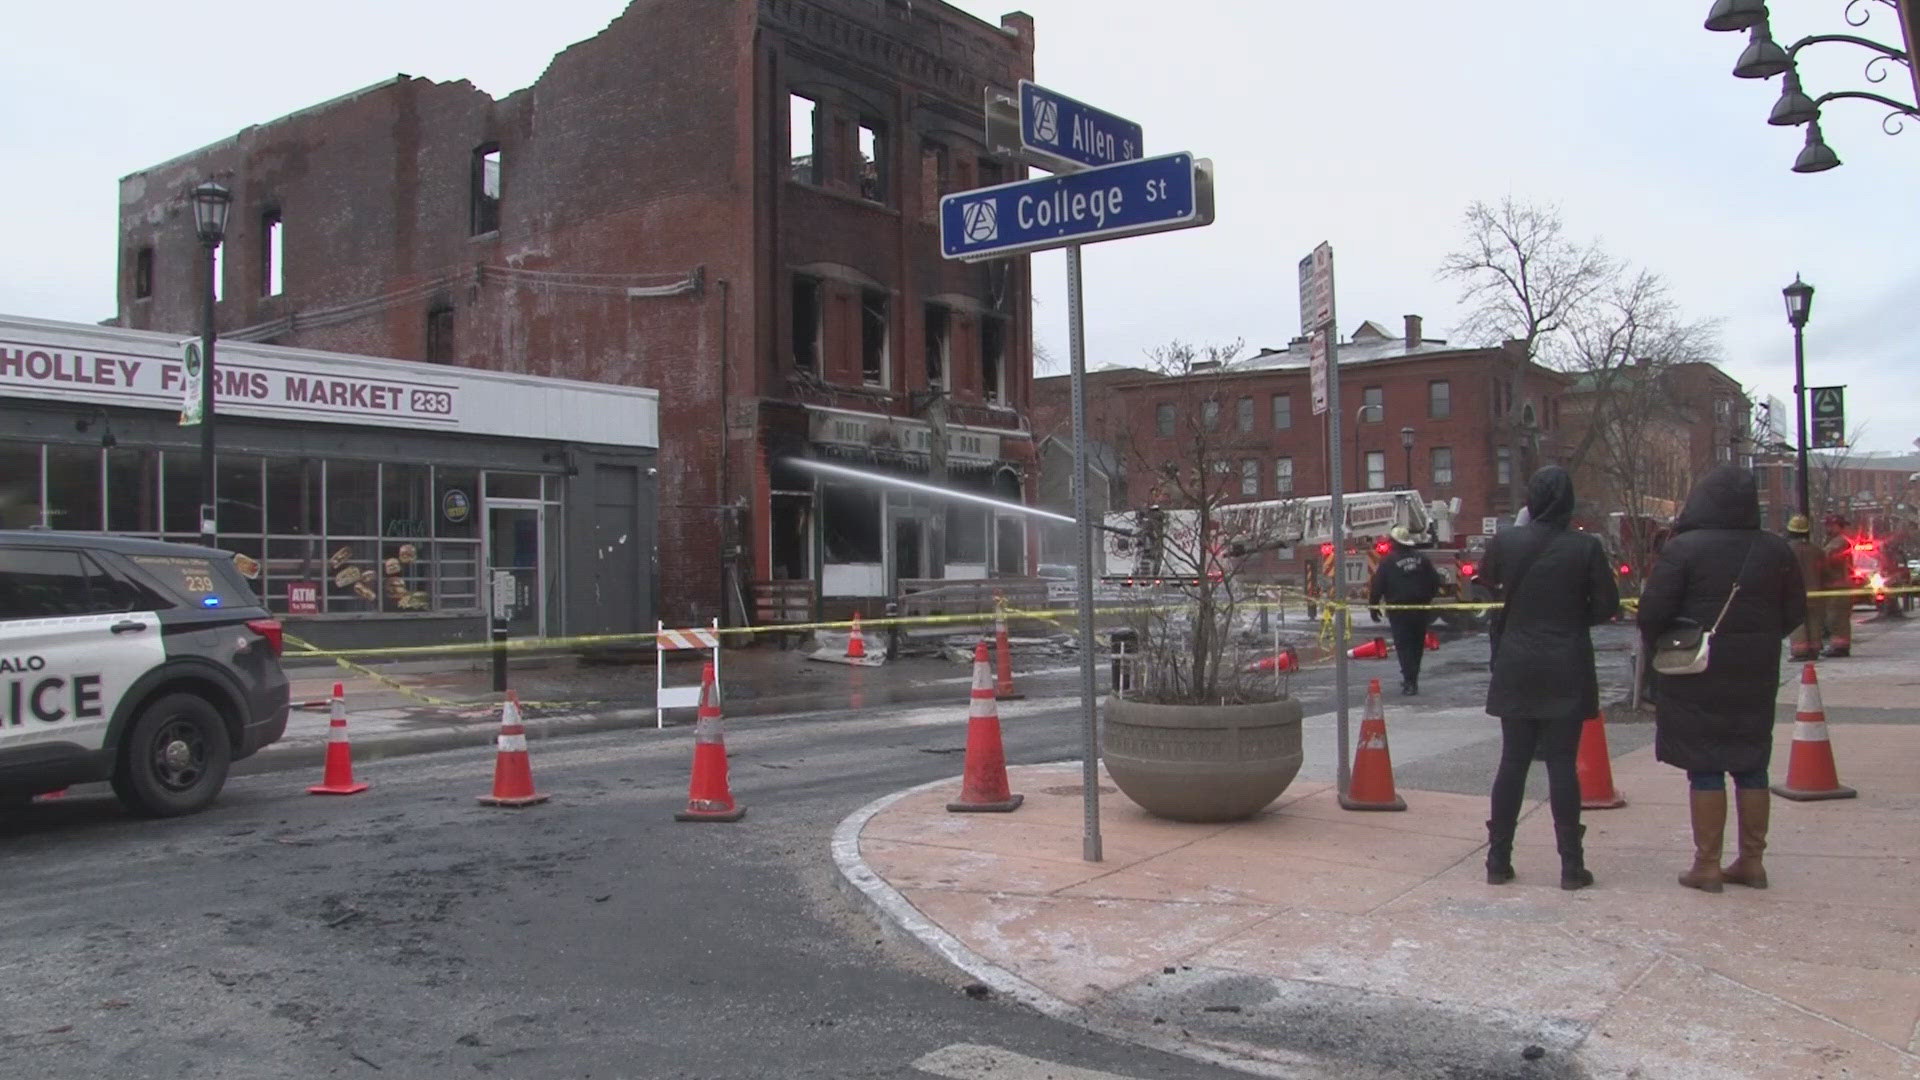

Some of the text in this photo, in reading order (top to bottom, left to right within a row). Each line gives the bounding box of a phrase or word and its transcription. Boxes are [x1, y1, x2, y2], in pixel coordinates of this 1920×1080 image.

[1072, 113, 1134, 161] Allen St
[1017, 178, 1167, 229] College St
[0, 348, 141, 388] HOLLEY
[161, 363, 268, 399] FRMS
[285, 376, 403, 410] MARKET
[413, 392, 449, 413] 233
[186, 576, 214, 592] 239
[292, 588, 316, 602] ATM
[1346, 562, 1363, 581] T7
[0, 674, 102, 726] ICE
